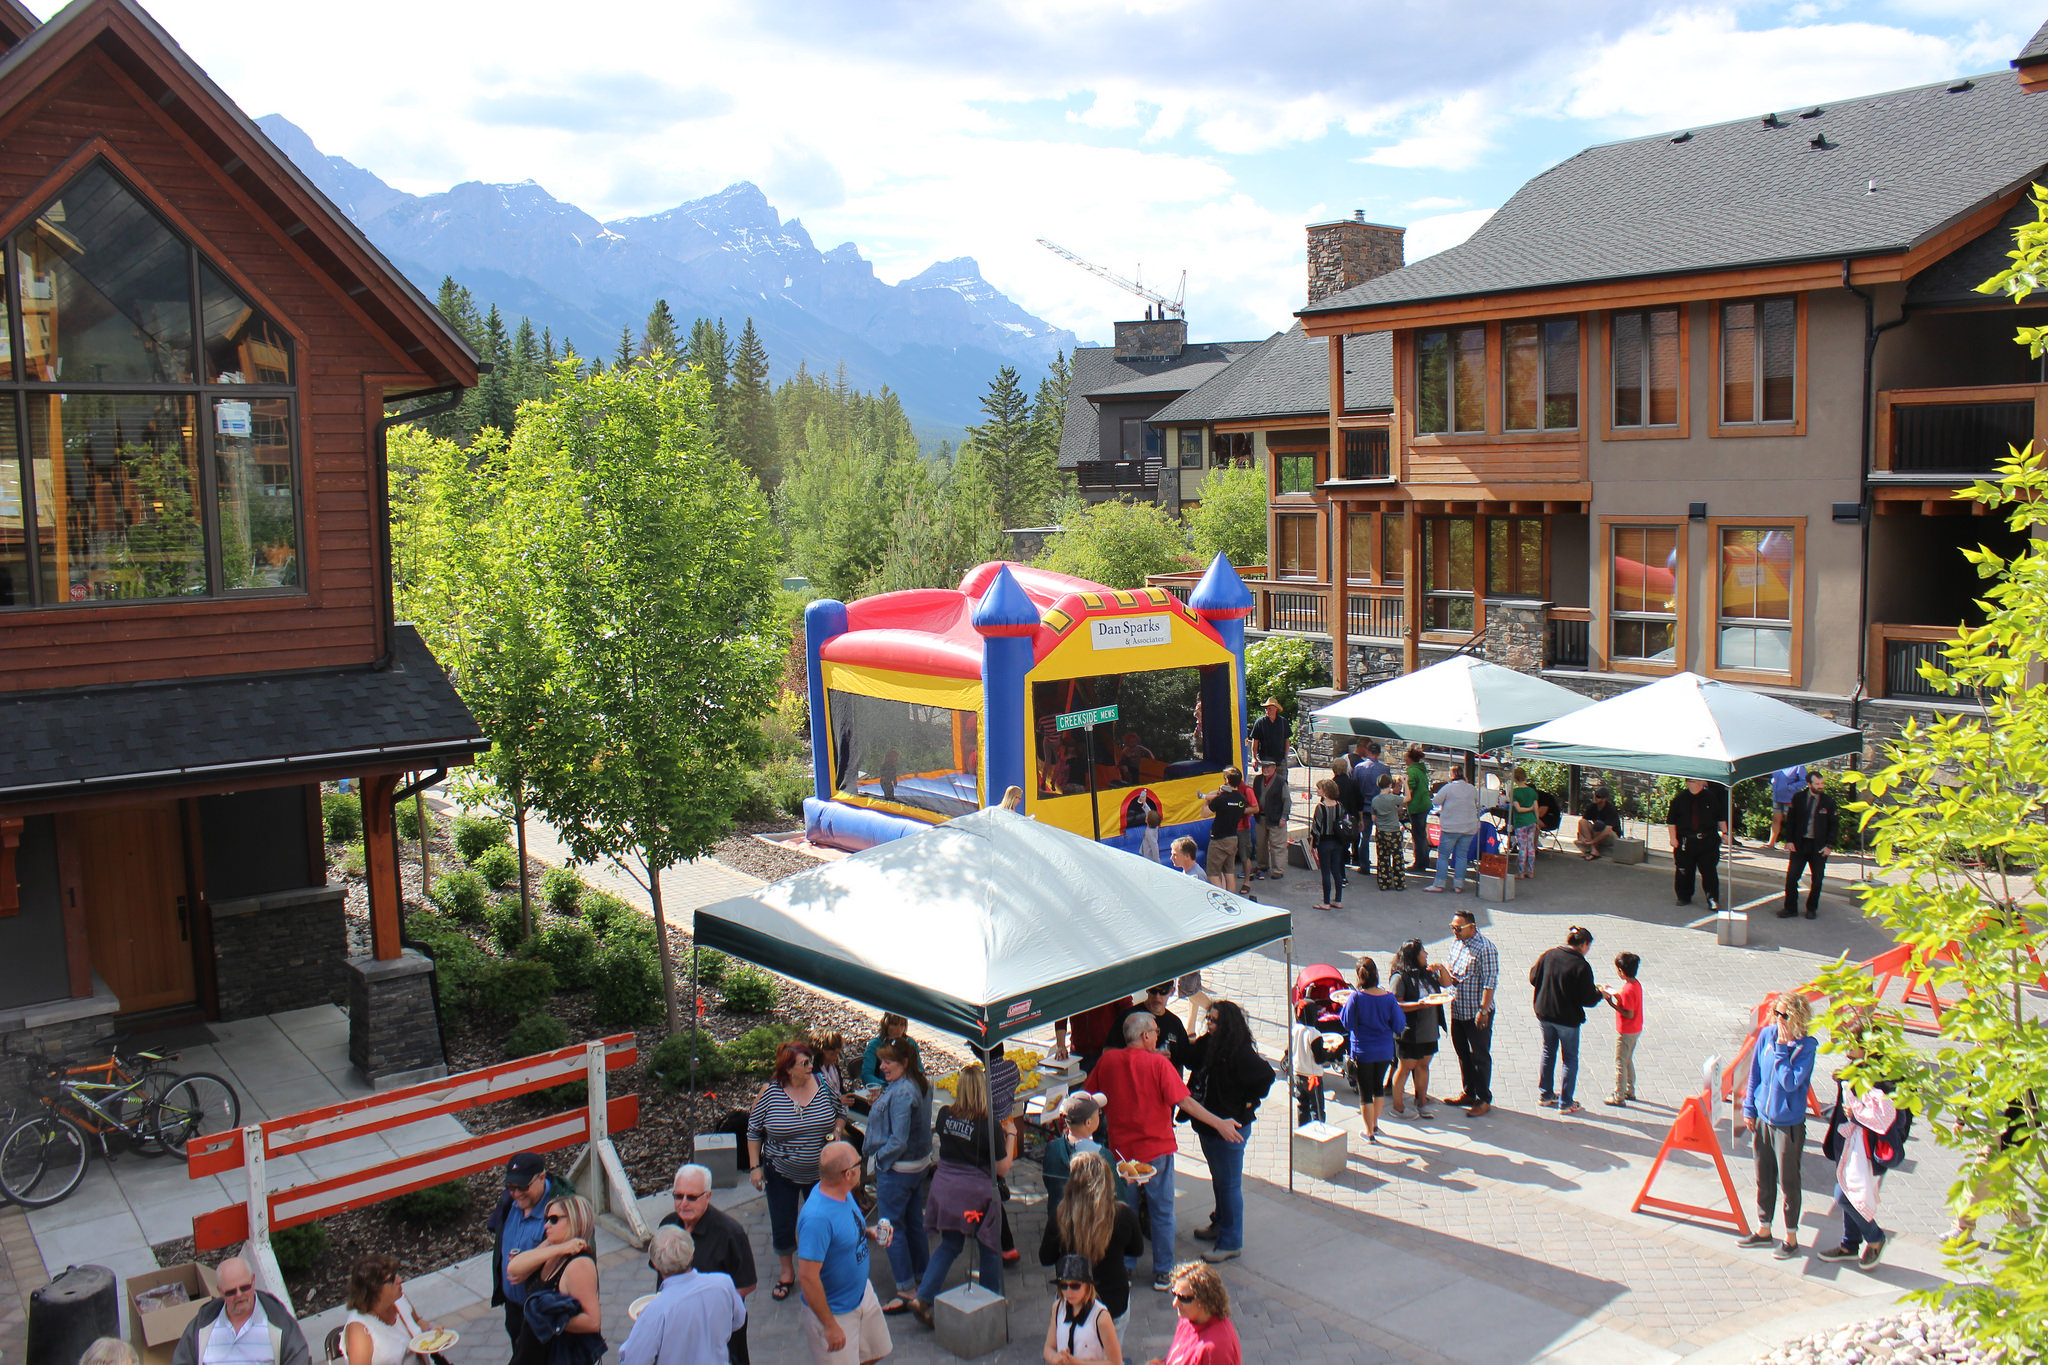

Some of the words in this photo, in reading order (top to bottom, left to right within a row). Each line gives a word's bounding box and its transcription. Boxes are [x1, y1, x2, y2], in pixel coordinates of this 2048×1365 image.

[1099, 623, 1121, 636] Dan
[1123, 618, 1160, 637] Sparks
[1125, 638, 1131, 646] &
[1132, 636, 1164, 645] Associates
[1059, 711, 1098, 728] CREEKSIDE
[79, 1094, 102, 1109] NEXT
[945, 1119, 975, 1137] BENTLEY
